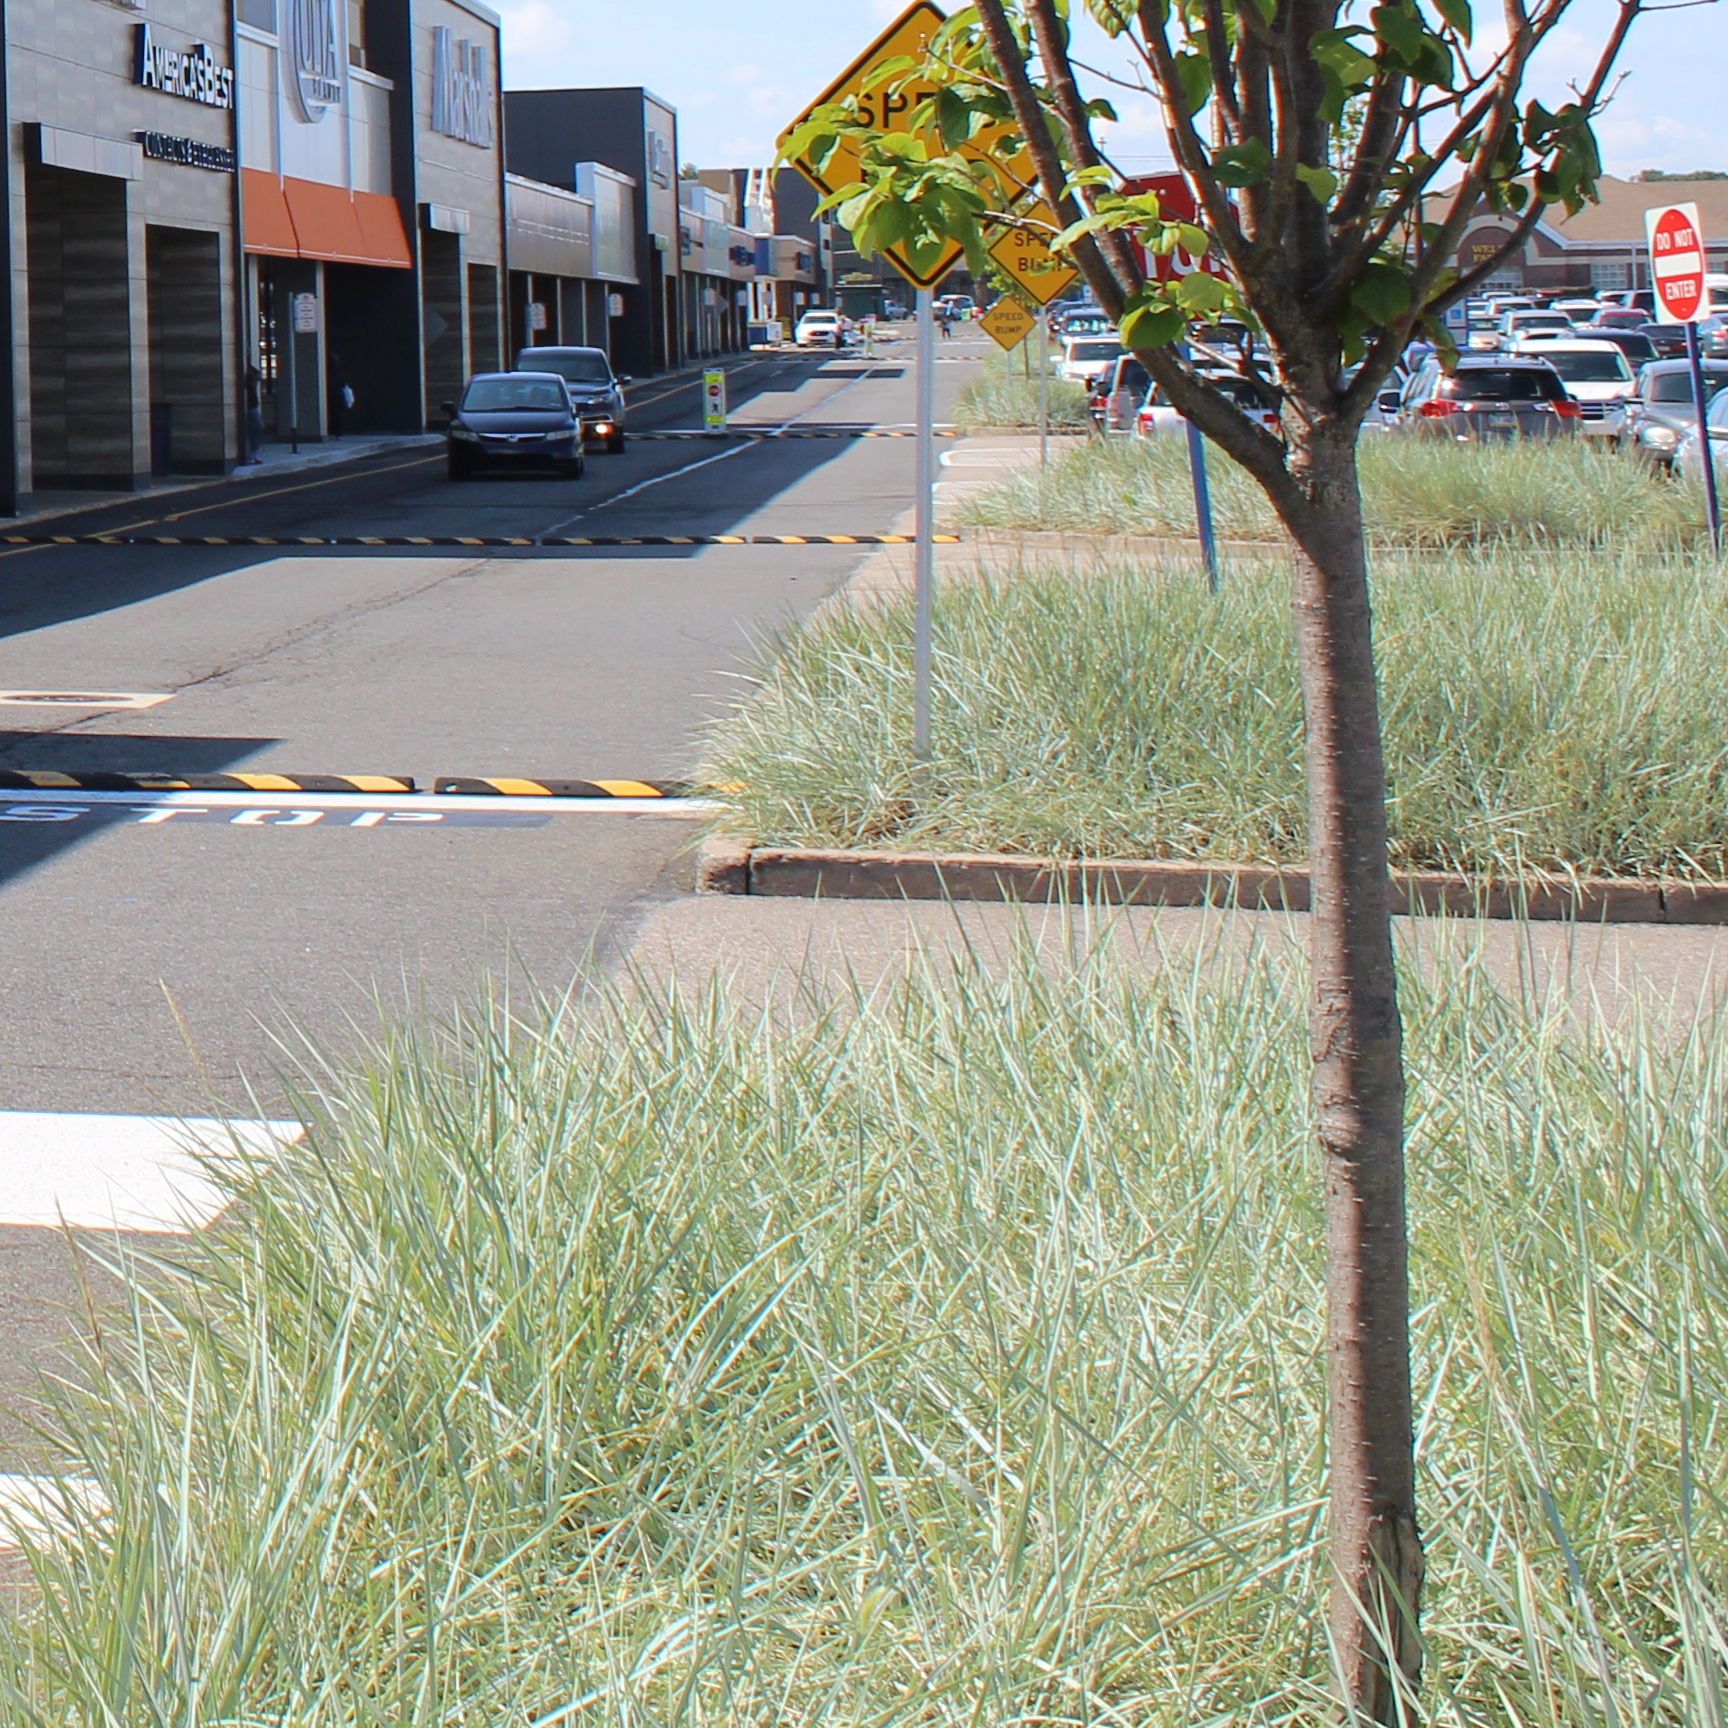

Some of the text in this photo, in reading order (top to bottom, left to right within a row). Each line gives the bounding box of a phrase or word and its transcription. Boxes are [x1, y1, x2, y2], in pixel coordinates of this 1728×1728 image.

[1656, 228, 1694, 251] DO NOT
[1665, 279, 1698, 301] ENTER
[993, 312, 1023, 321] SPEED
[995, 325, 1022, 334] BUMP
